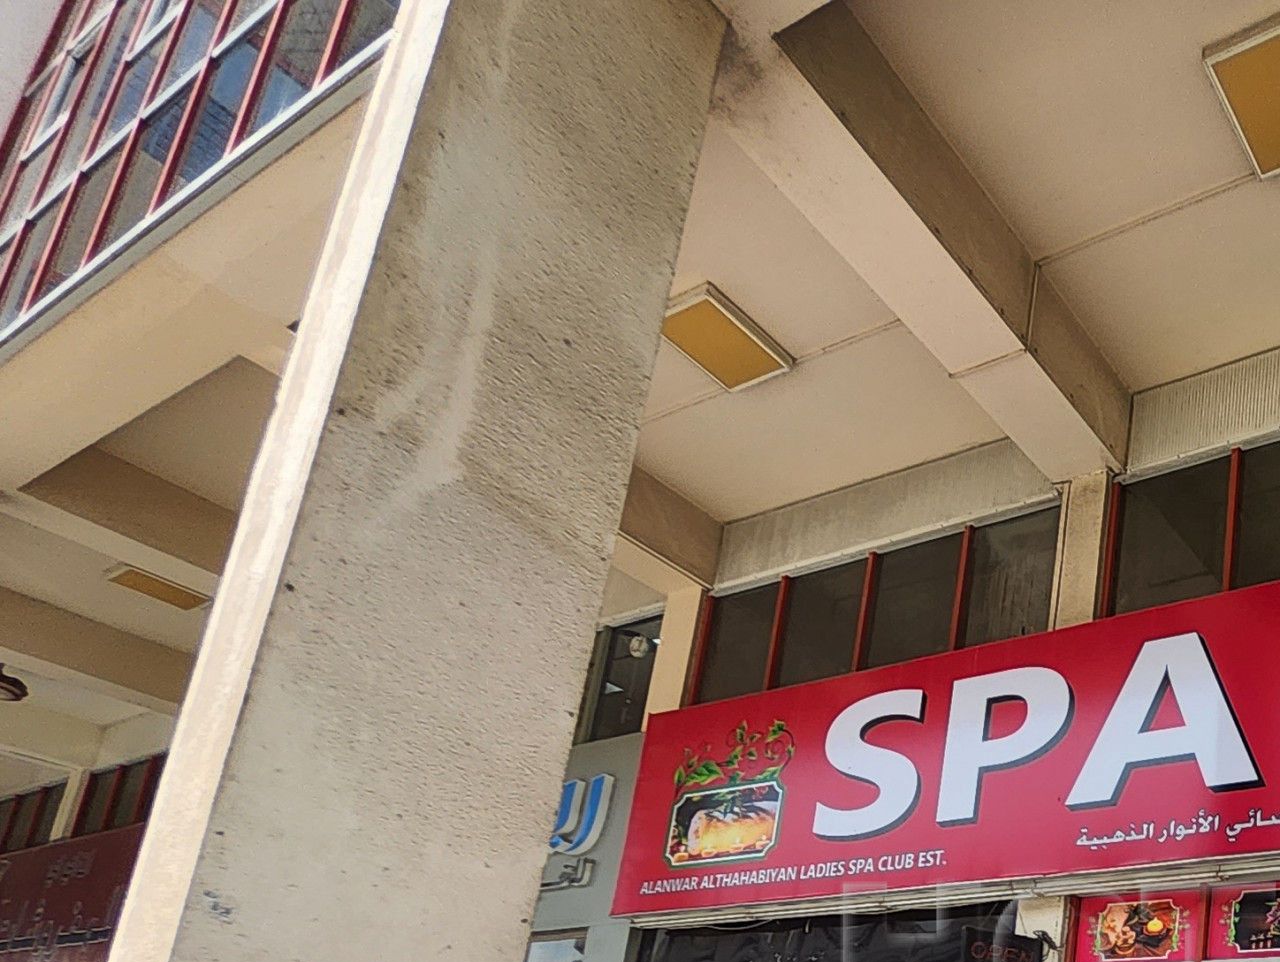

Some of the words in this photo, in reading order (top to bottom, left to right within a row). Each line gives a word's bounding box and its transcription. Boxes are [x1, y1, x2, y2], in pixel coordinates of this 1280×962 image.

[812, 632, 1265, 838] SPA
[1076, 821, 1154, 850] الذهبية
[1157, 809, 1219, 843] الأنوار
[640, 876, 699, 895] ALANWAR
[700, 866, 797, 890] ALTHAHABIYAN
[800, 861, 846, 880] LADIES
[848, 857, 874, 875] SPA
[878, 853, 914, 872] CLUB
[917, 849, 947, 868] EST.
